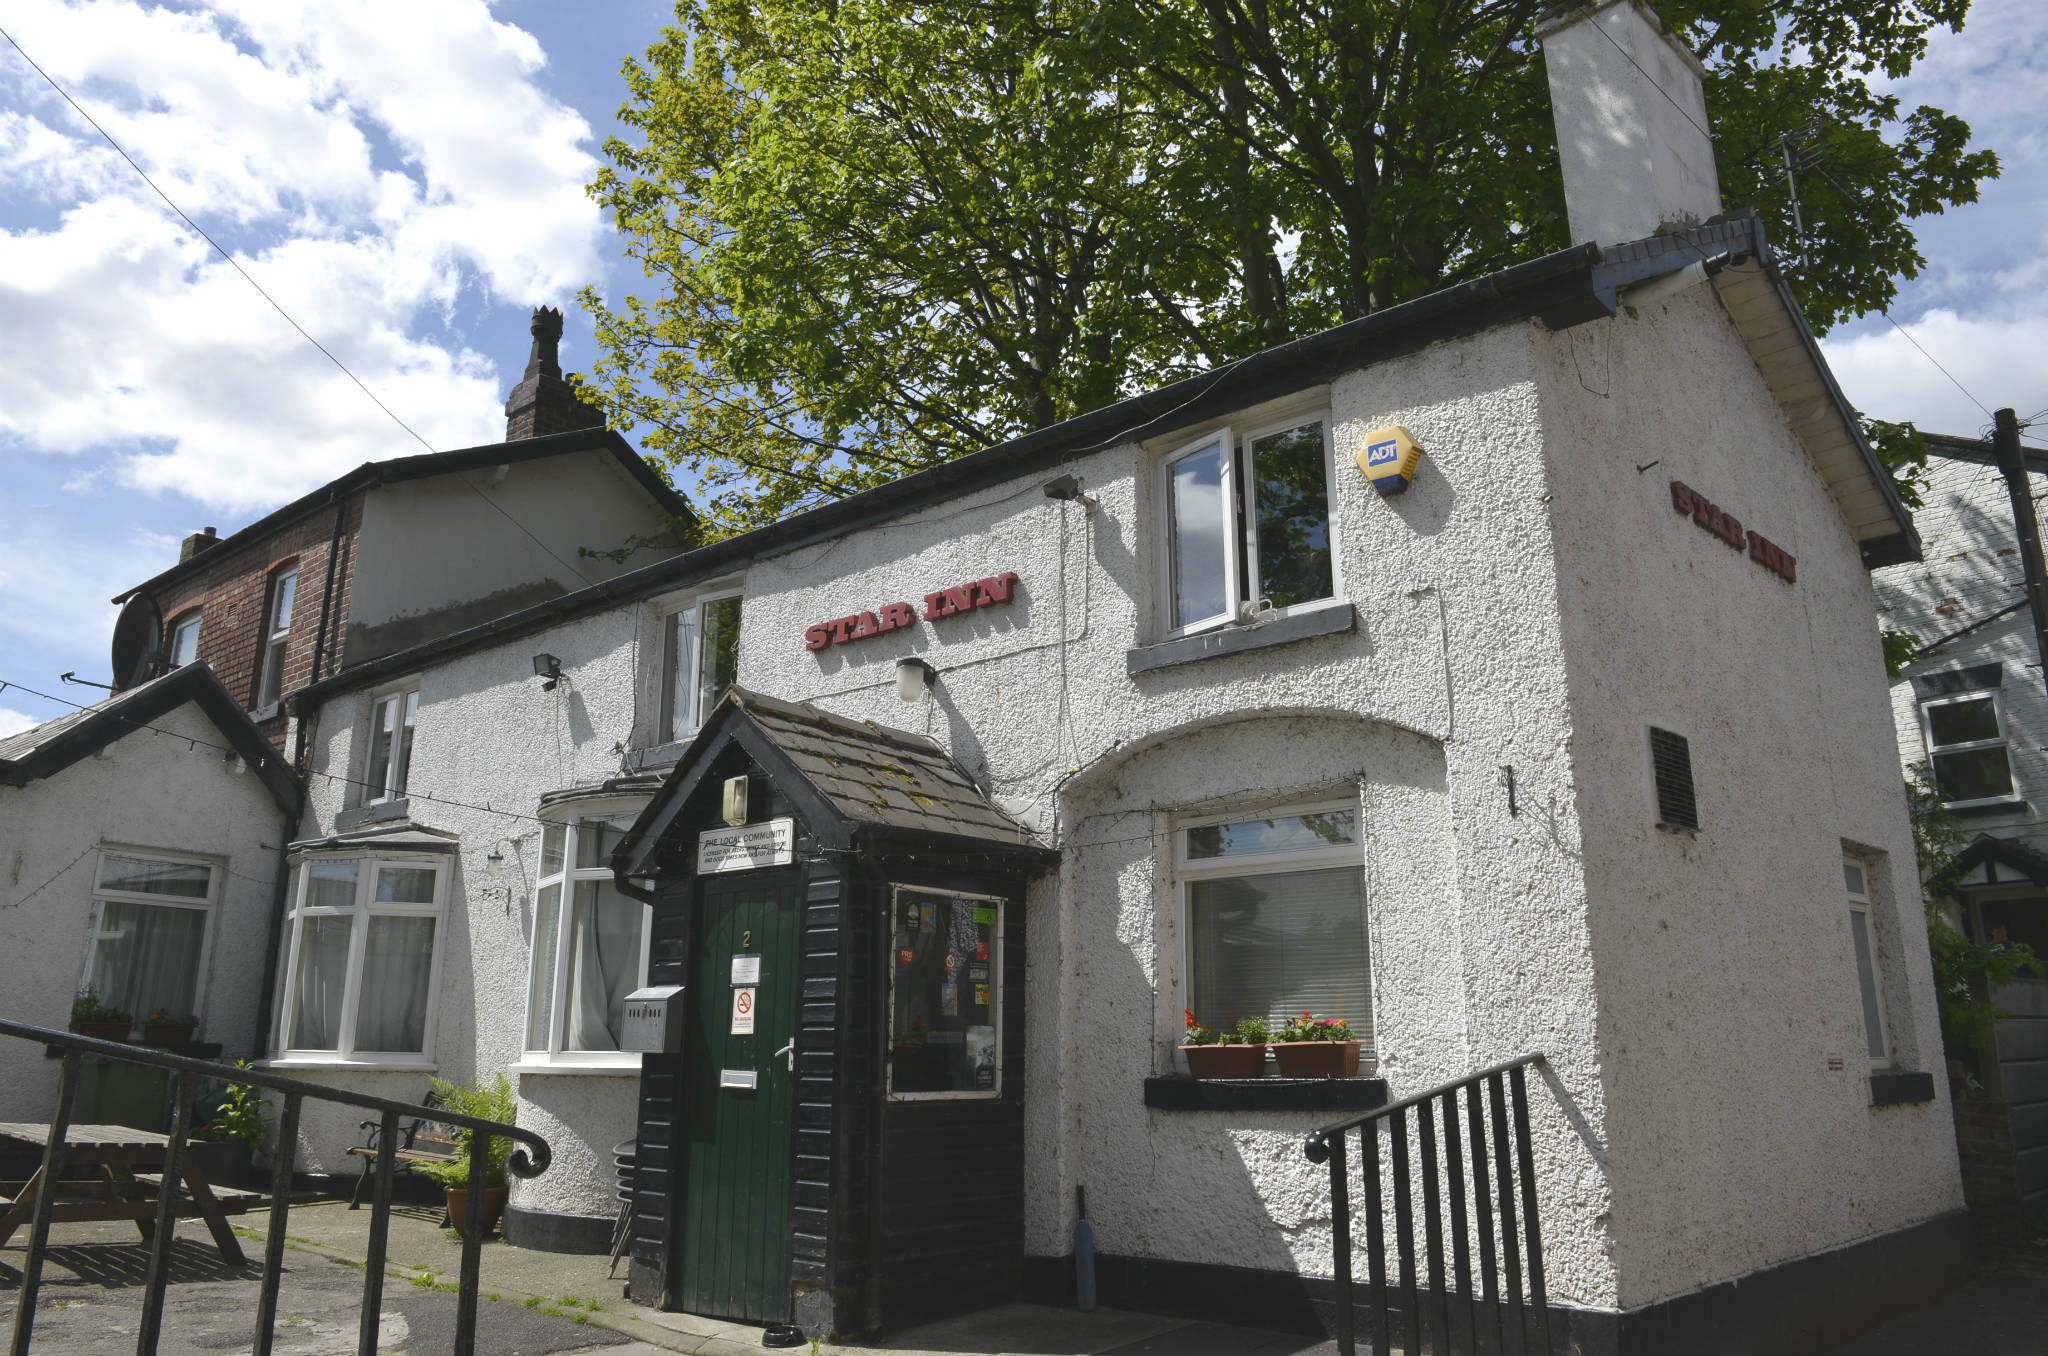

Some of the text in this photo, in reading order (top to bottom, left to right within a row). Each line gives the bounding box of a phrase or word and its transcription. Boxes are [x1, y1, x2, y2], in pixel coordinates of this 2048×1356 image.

[1369, 443, 1396, 463] ADT
[1670, 480, 1797, 584] STAR INN
[805, 571, 1019, 652] STAR INN
[720, 836, 742, 846] LOCAL
[743, 829, 786, 842] COMMUNITY
[743, 930, 751, 948] 2
